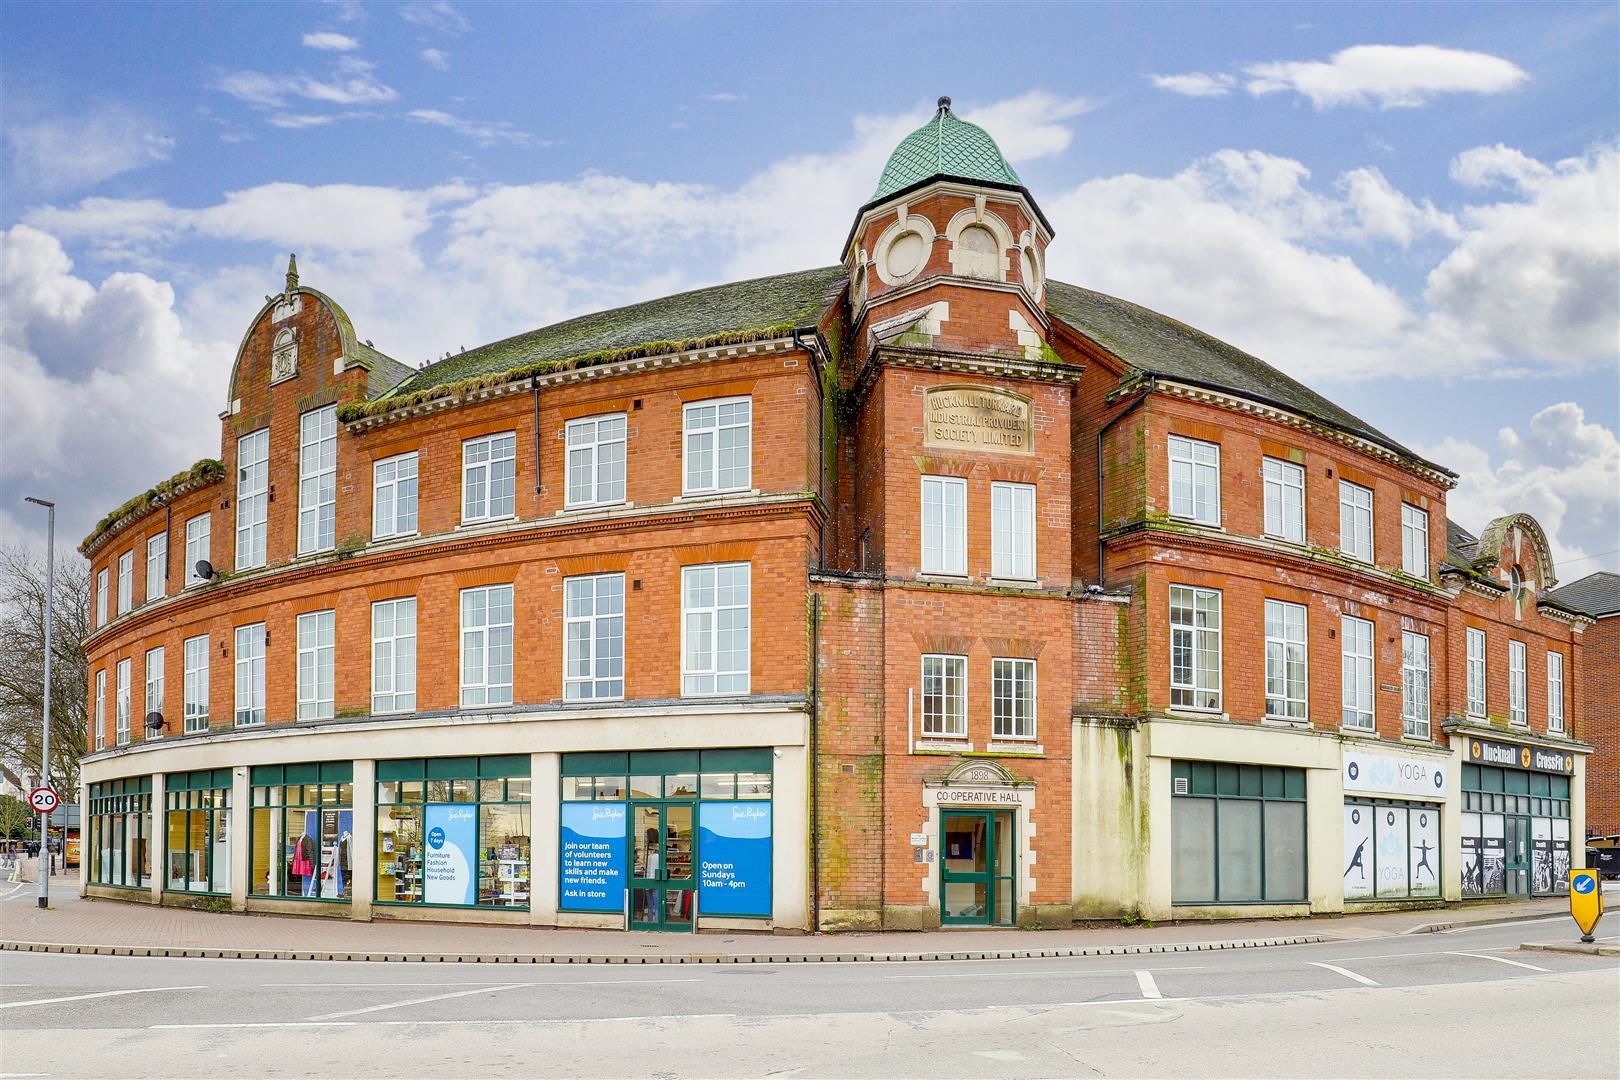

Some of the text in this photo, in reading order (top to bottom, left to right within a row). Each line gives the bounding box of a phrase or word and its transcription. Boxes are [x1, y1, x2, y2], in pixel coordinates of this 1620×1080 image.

[931, 394, 979, 410] HUCKNALL
[929, 411, 1027, 431] INDUSTRIAL PROVIDENT
[935, 428, 1023, 447] SOCIETY LIMITED
[1482, 743, 1564, 771] Hucknall CrossFit
[971, 771, 989, 780] 1898
[1398, 763, 1427, 781] YOGA
[34, 795, 54, 805] 20
[1000, 792, 1022, 803] HALL
[564, 842, 578, 850] Join
[574, 851, 612, 859] volunteers
[702, 861, 722, 871] Open
[584, 868, 598, 876] and
[702, 870, 735, 880] Sundays
[1379, 866, 1403, 881] YOGA
[581, 877, 608, 885] friends.
[703, 880, 723, 888] 10am
[728, 880, 746, 889] 4pm
[587, 890, 606, 898] store
